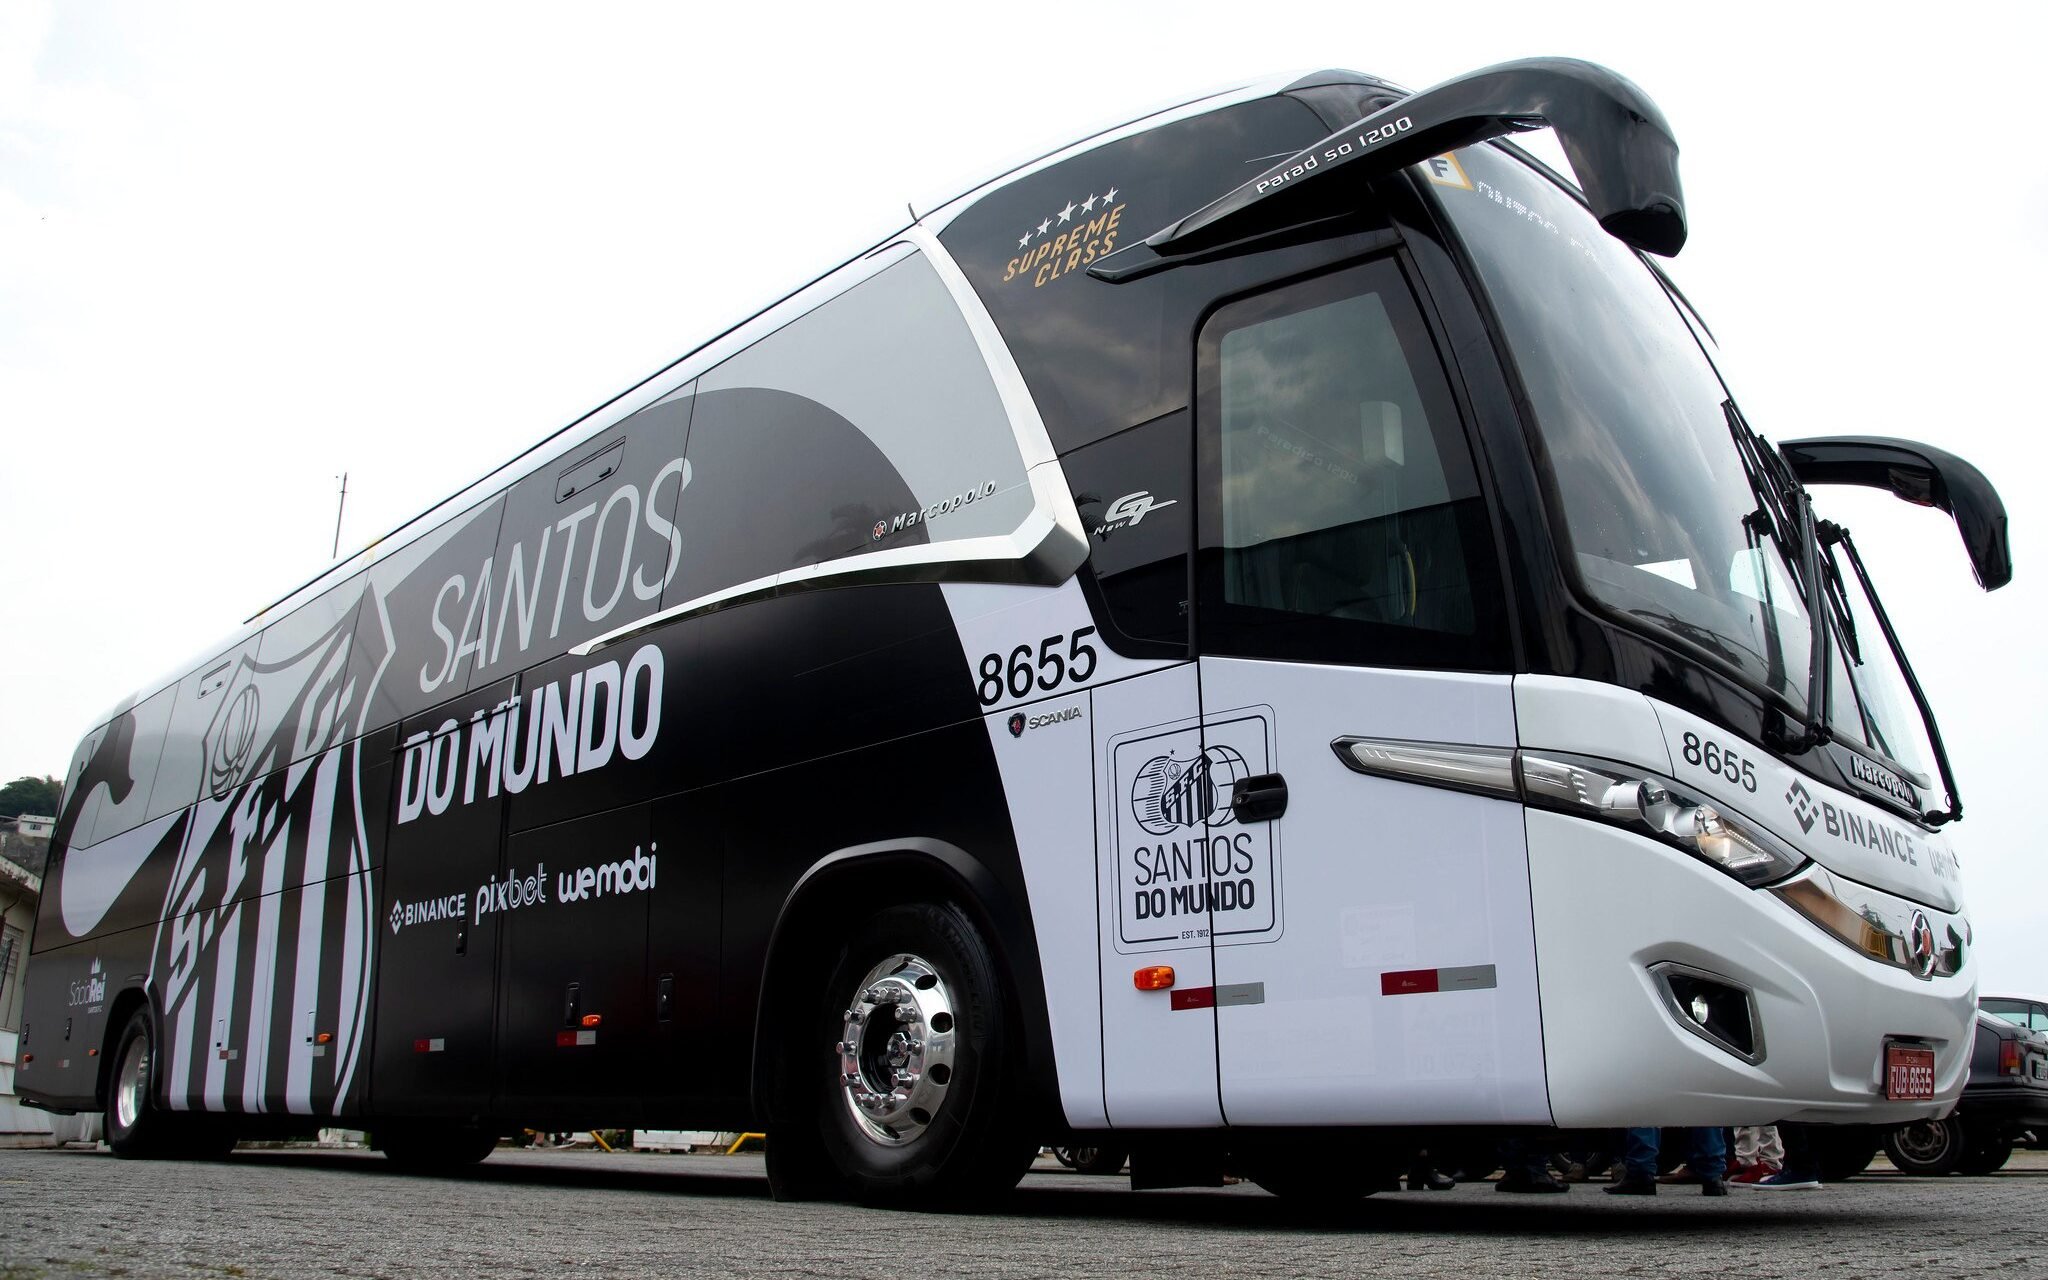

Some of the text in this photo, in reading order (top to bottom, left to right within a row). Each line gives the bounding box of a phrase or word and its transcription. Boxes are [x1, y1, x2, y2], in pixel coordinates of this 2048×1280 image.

[1358, 116, 1413, 147] 1200
[1003, 203, 1126, 282] SUPREME
[1035, 230, 1118, 288] CLASS
[891, 480, 996, 533] Marcopolo
[419, 457, 692, 693] SANTOS
[977, 625, 1097, 706] 8655
[398, 644, 664, 825] DO MUNDO
[1029, 705, 1082, 730] SCANIA
[1682, 731, 1757, 794] 8655
[1134, 832, 1254, 887] SANTOS
[1821, 800, 1917, 867] BINANCE
[405, 842, 657, 926] BINANCE pixbet wemobi
[1135, 878, 1255, 920] DO MUNDO
[1181, 929, 1210, 940] EST. 1912
